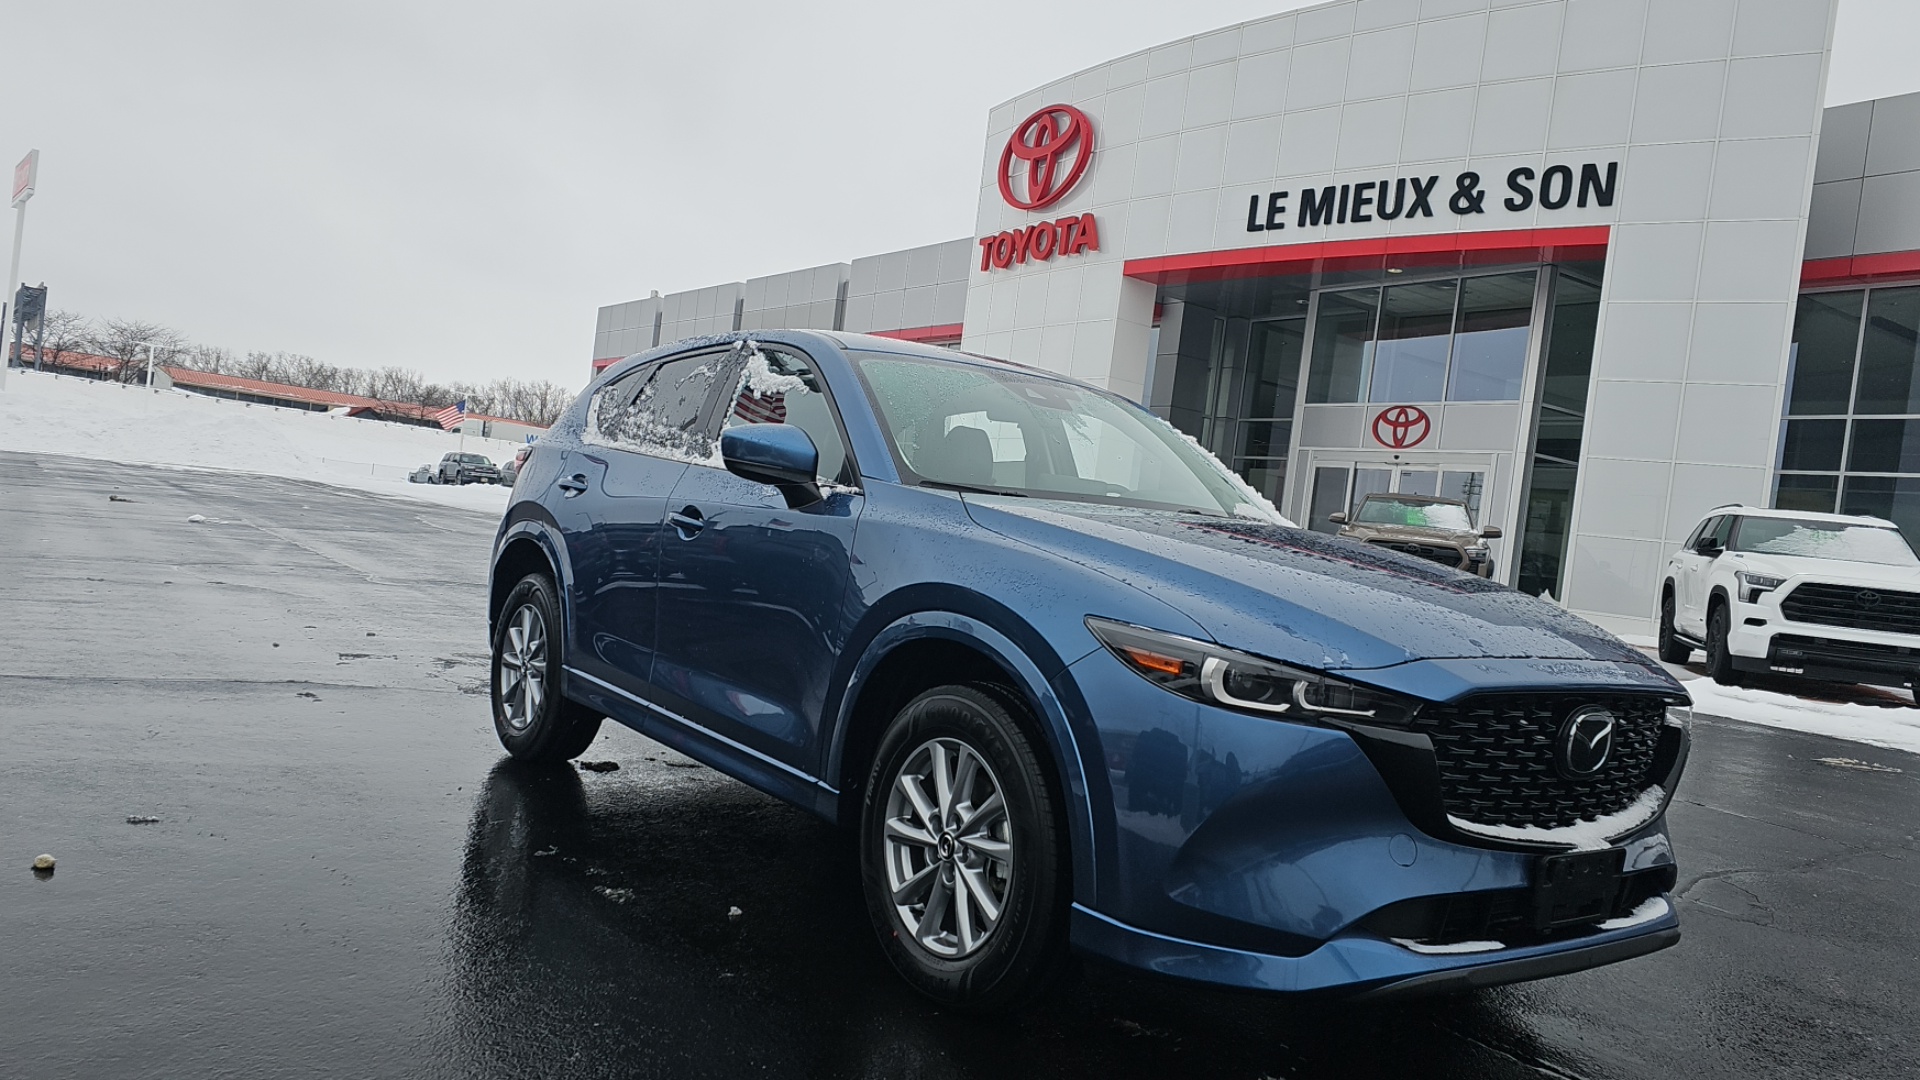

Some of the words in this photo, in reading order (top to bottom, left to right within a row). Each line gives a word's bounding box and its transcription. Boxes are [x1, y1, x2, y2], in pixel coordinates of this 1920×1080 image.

[1247, 191, 1289, 232] LE
[1298, 176, 1440, 228] MIEUX
[1449, 172, 1486, 216] &
[1504, 161, 1619, 212] SON
[980, 213, 1100, 272] TOYOTA
